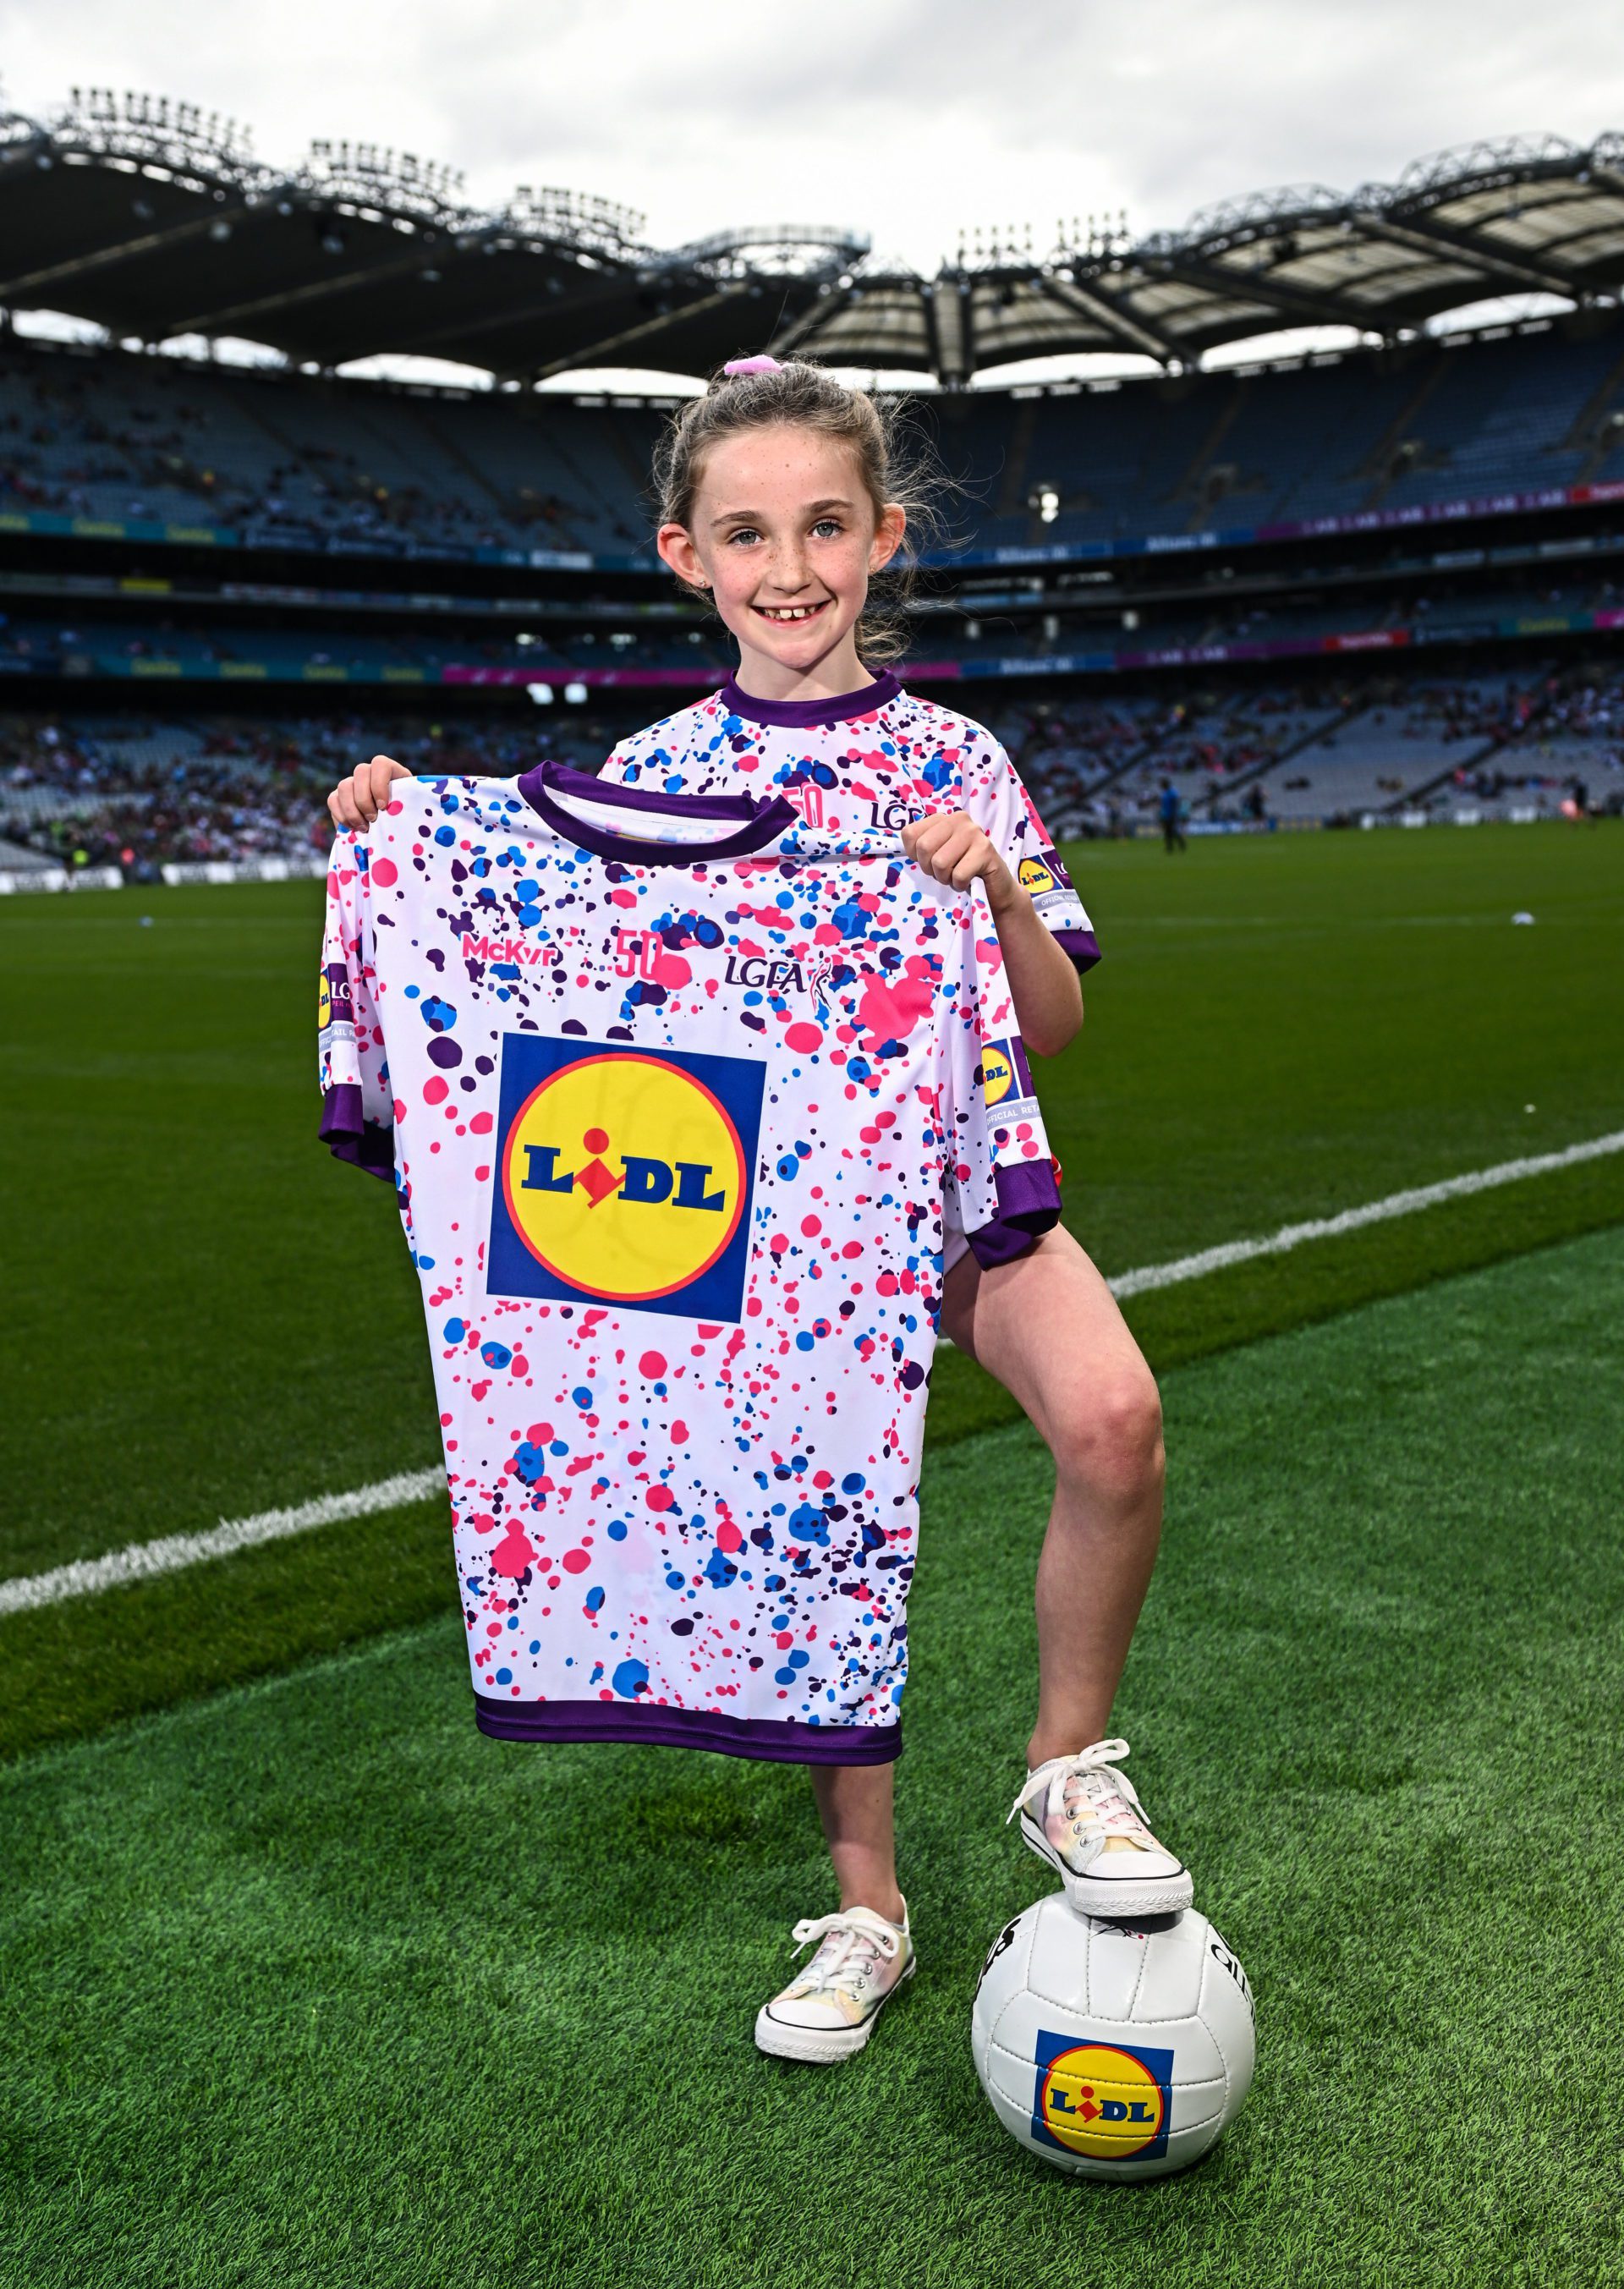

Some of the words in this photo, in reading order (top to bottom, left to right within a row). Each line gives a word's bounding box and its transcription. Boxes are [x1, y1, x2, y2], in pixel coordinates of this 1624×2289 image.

[615, 929, 663, 980] 50
[724, 955, 808, 993] LGFA
[987, 1110, 1018, 1126] FFICIAL
